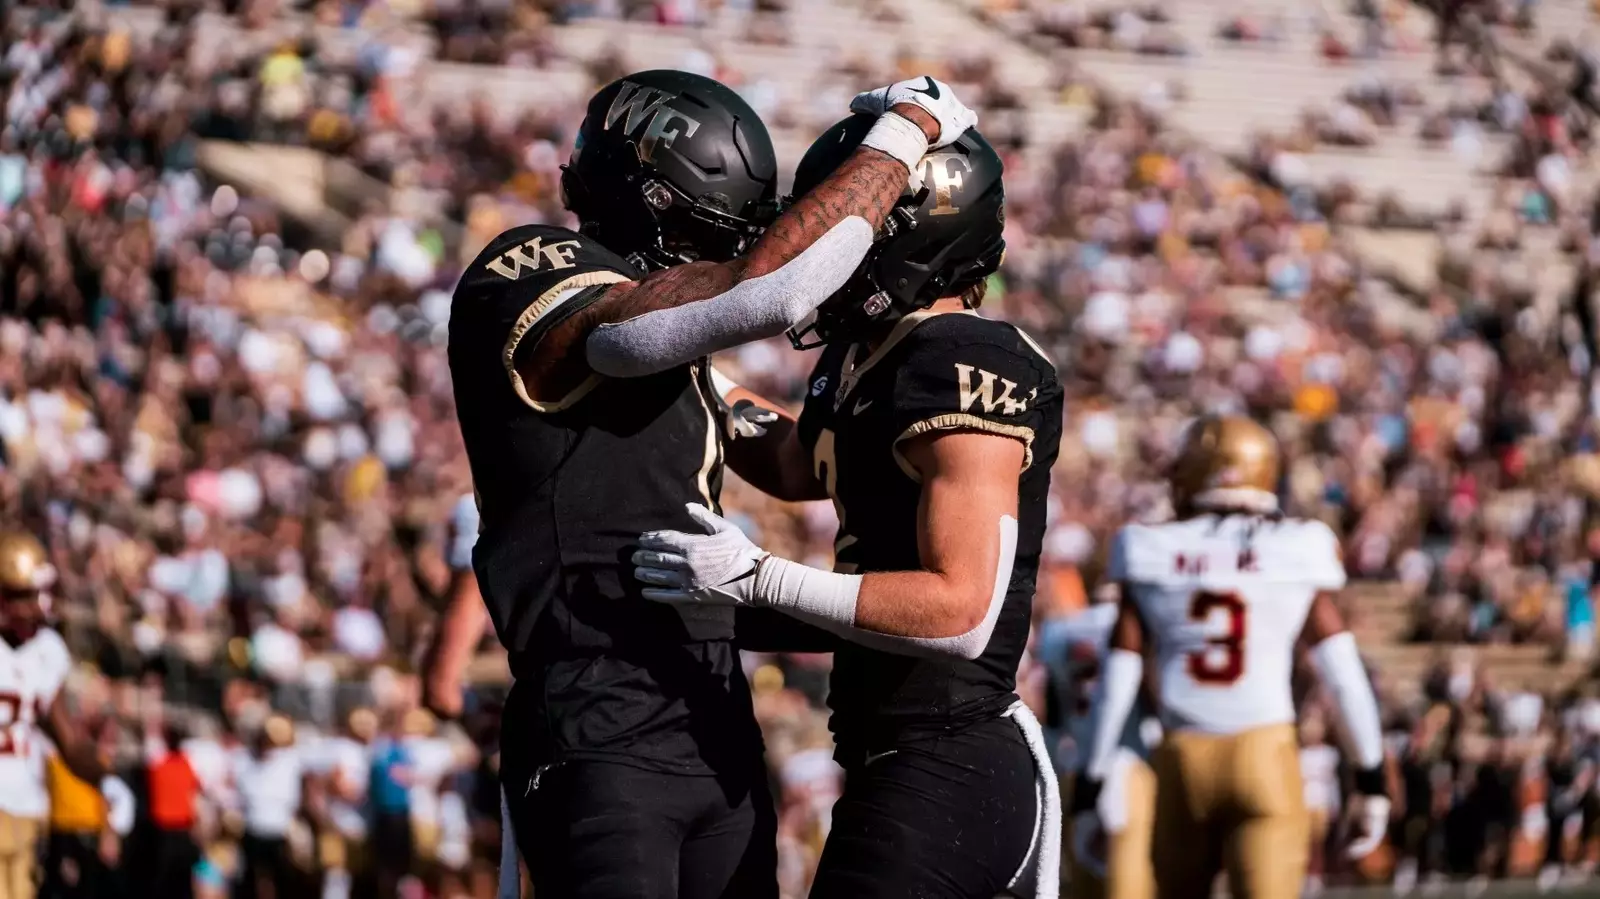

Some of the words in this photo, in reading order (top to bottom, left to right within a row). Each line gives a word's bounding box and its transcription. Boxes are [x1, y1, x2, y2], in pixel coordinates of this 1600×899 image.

[603, 80, 700, 165] WF
[485, 236, 582, 280] WF
[1186, 588, 1250, 687] 3
